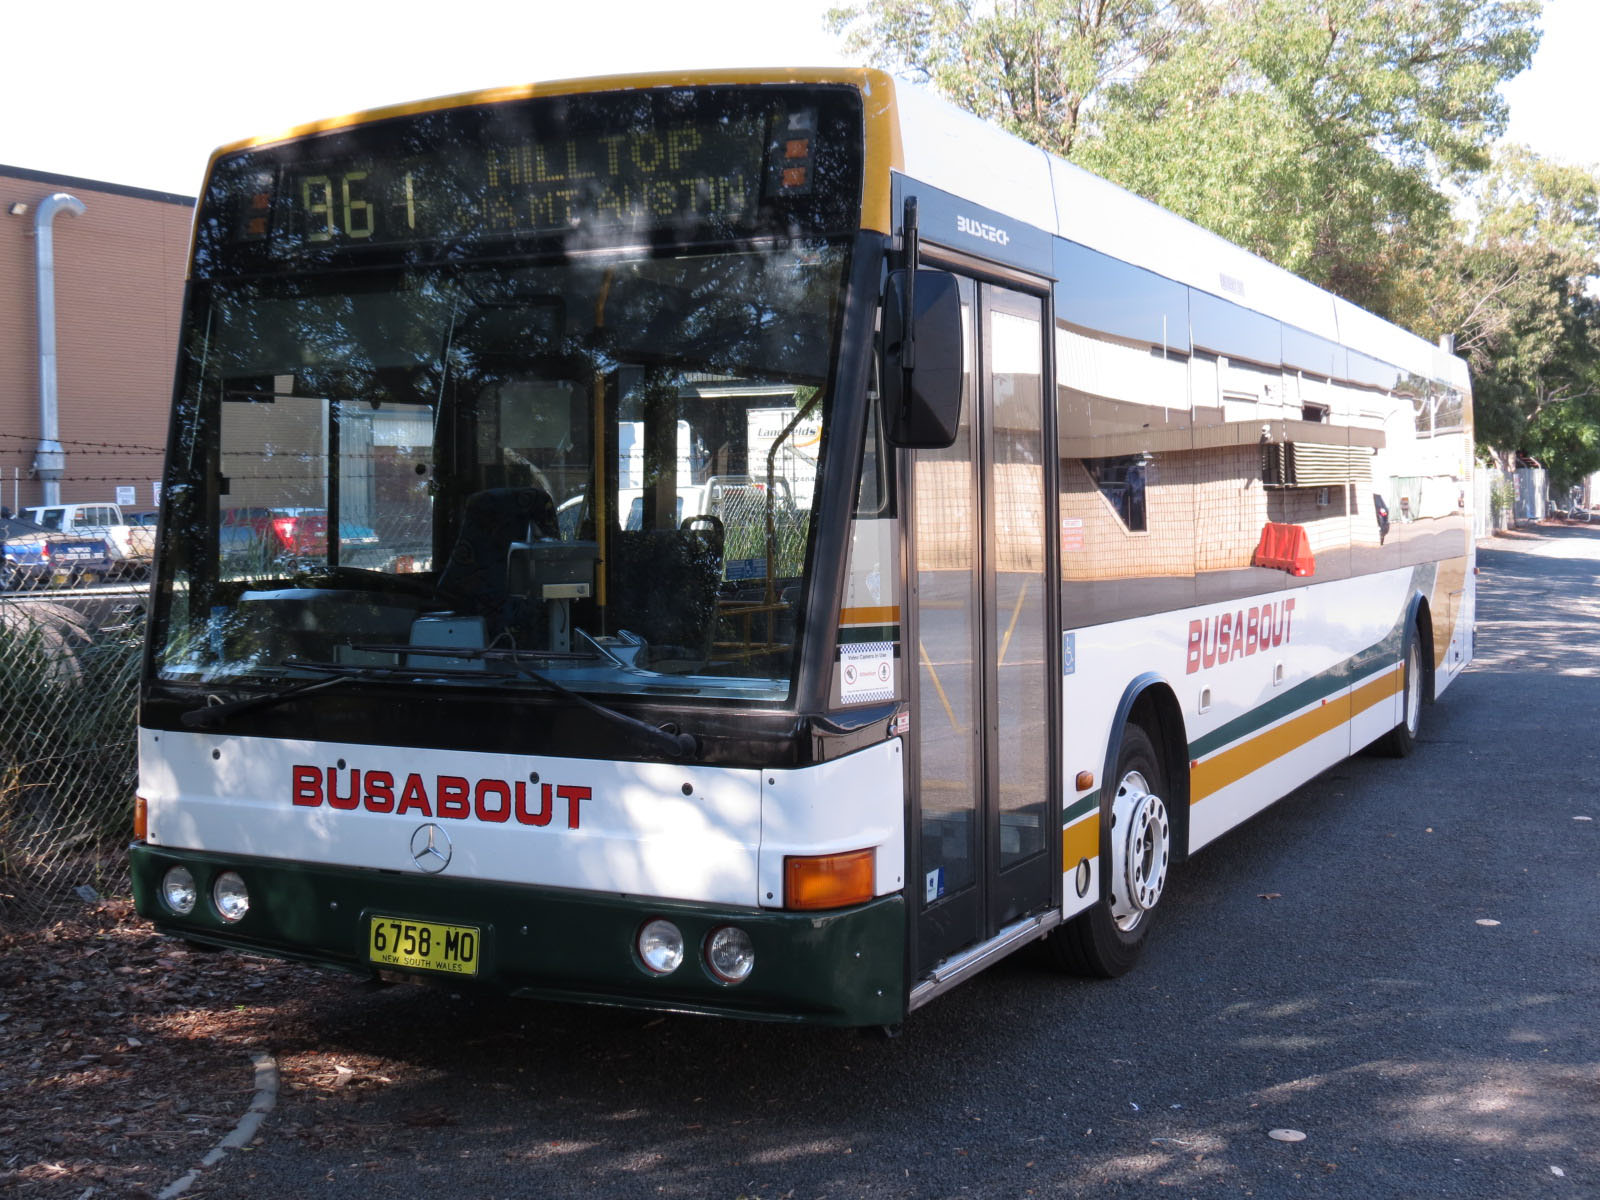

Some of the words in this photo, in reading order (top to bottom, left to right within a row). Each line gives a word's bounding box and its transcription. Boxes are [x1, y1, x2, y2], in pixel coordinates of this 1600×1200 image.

[303, 171, 416, 241] 961
[597, 174, 745, 219] AUSTIN
[1186, 598, 1296, 675] BUSABOUT
[292, 765, 592, 830] BUSABOUT
[382, 954, 400, 963] NEW
[404, 957, 431, 968] SOUTH
[436, 961, 462, 972] WALES
